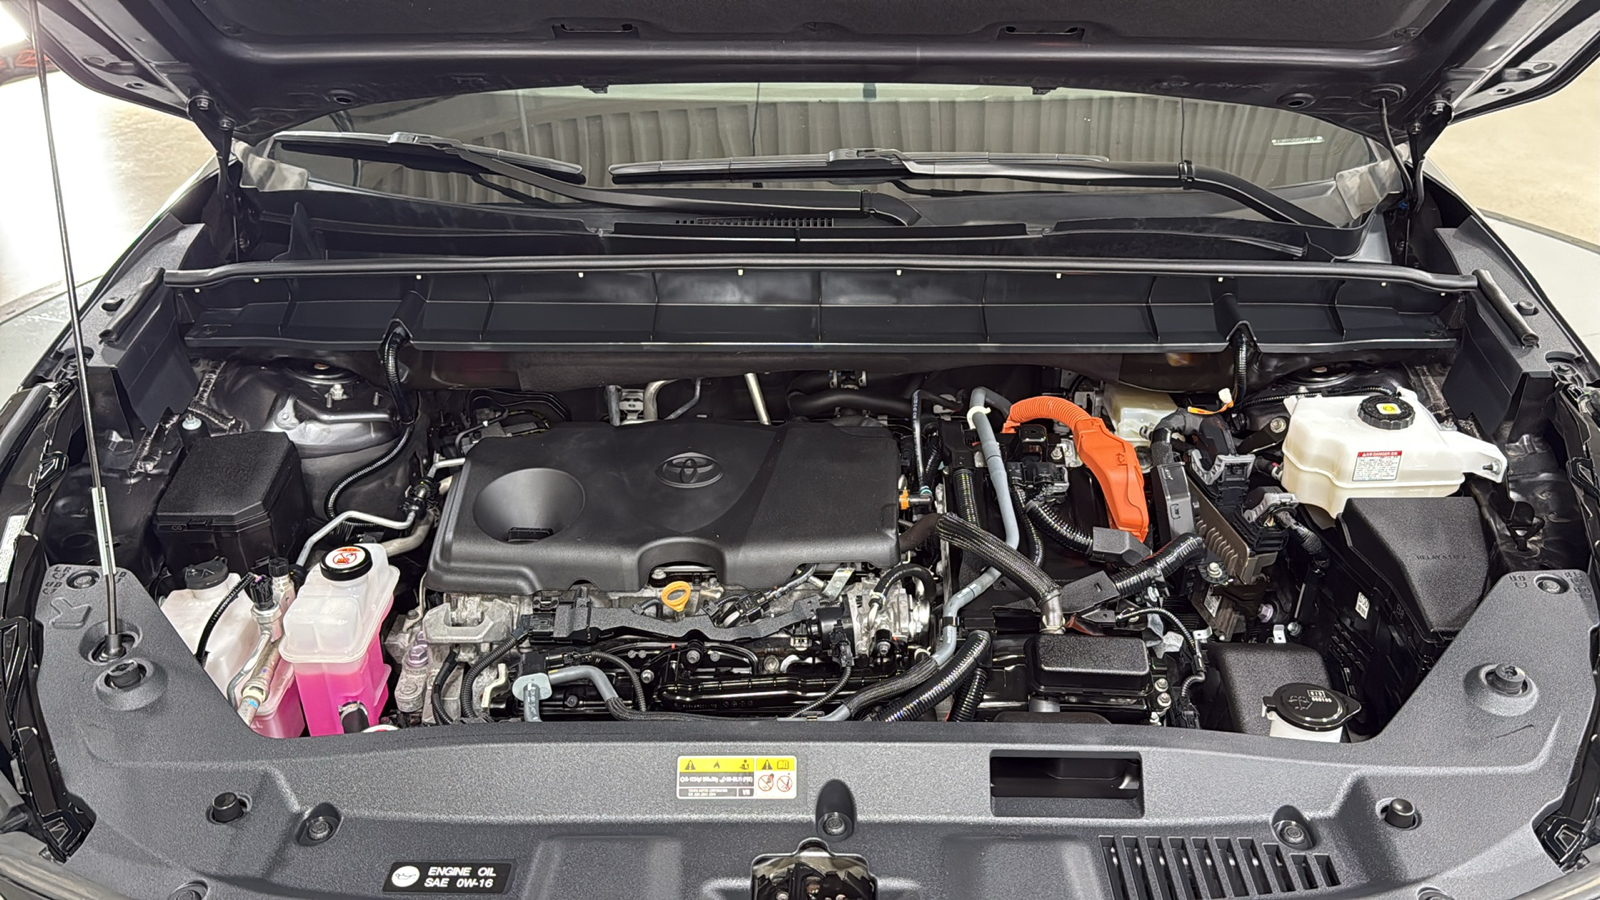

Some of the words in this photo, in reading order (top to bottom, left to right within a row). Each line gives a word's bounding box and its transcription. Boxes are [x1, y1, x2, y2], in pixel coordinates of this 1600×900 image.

[428, 866, 472, 876] ENGINE
[477, 867, 496, 877] OIL
[424, 878, 450, 888] SAE
[456, 878, 494, 888] 0W-16
